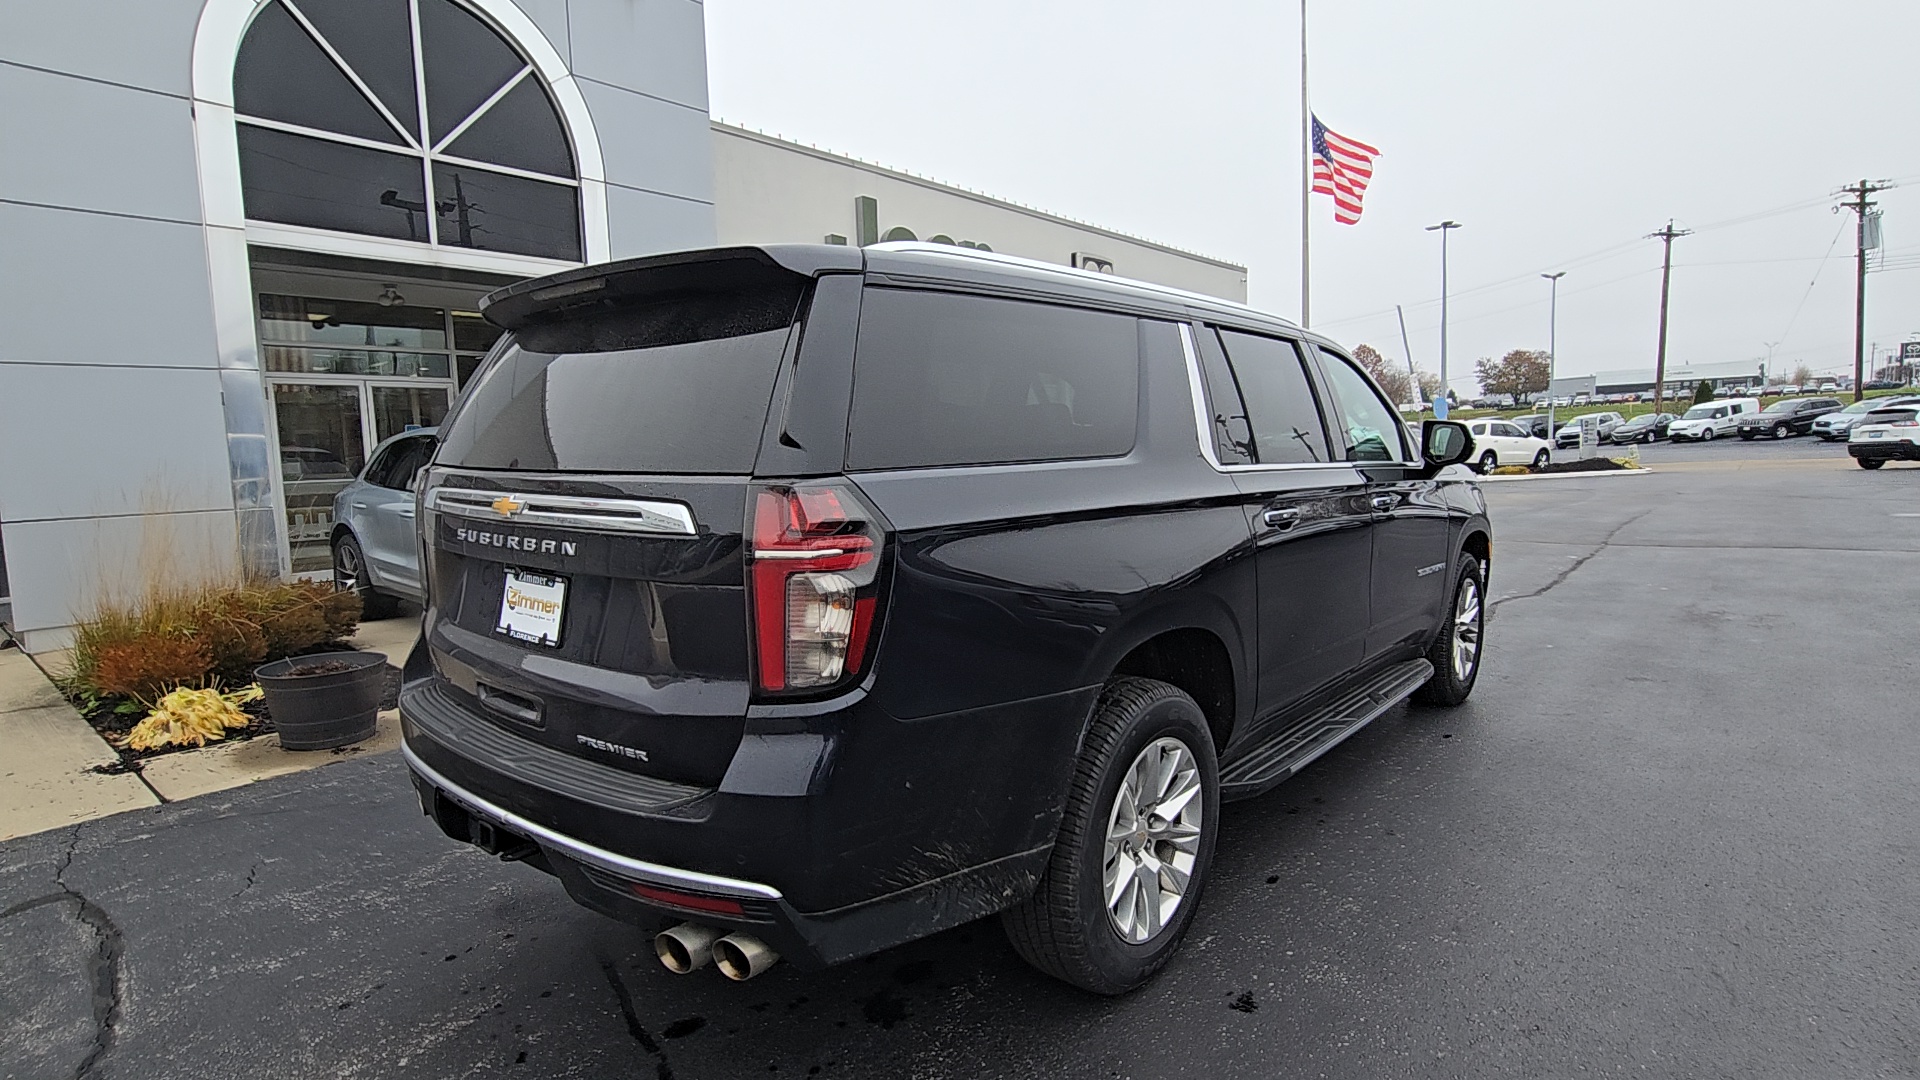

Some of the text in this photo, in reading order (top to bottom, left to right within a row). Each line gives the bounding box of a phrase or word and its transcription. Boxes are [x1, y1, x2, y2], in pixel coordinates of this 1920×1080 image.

[456, 528, 577, 556] SUBURBAN
[518, 571, 548, 586] Zimmer
[508, 588, 560, 615] Zimmer
[509, 630, 540, 644] FLORENCE
[576, 734, 649, 762] PREMIER
